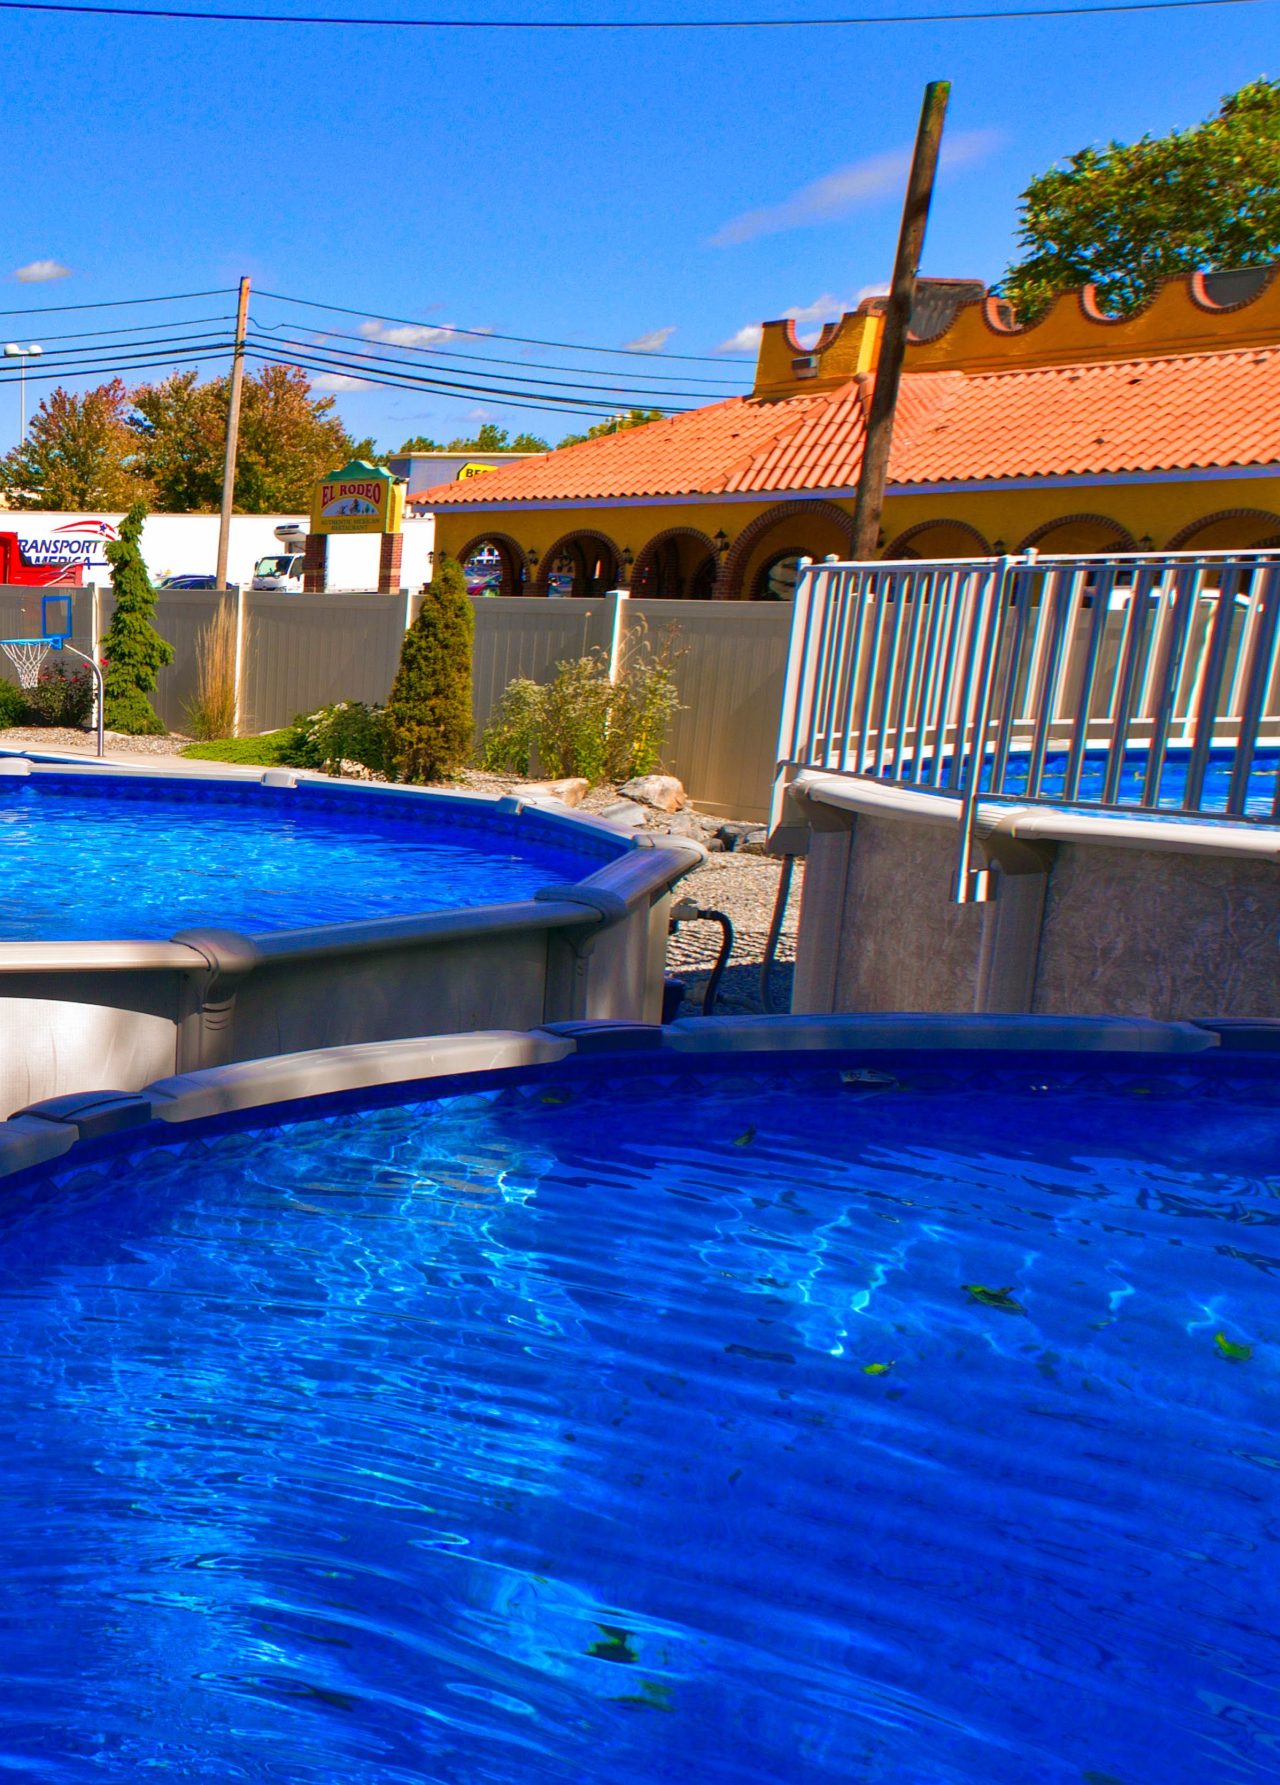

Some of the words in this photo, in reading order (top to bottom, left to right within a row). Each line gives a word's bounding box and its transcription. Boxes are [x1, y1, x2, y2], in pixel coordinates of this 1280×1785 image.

[466, 468, 488, 478] BE
[321, 485, 336, 508] EL
[339, 483, 381, 504] RODEO
[19, 539, 100, 554] RANSPORT
